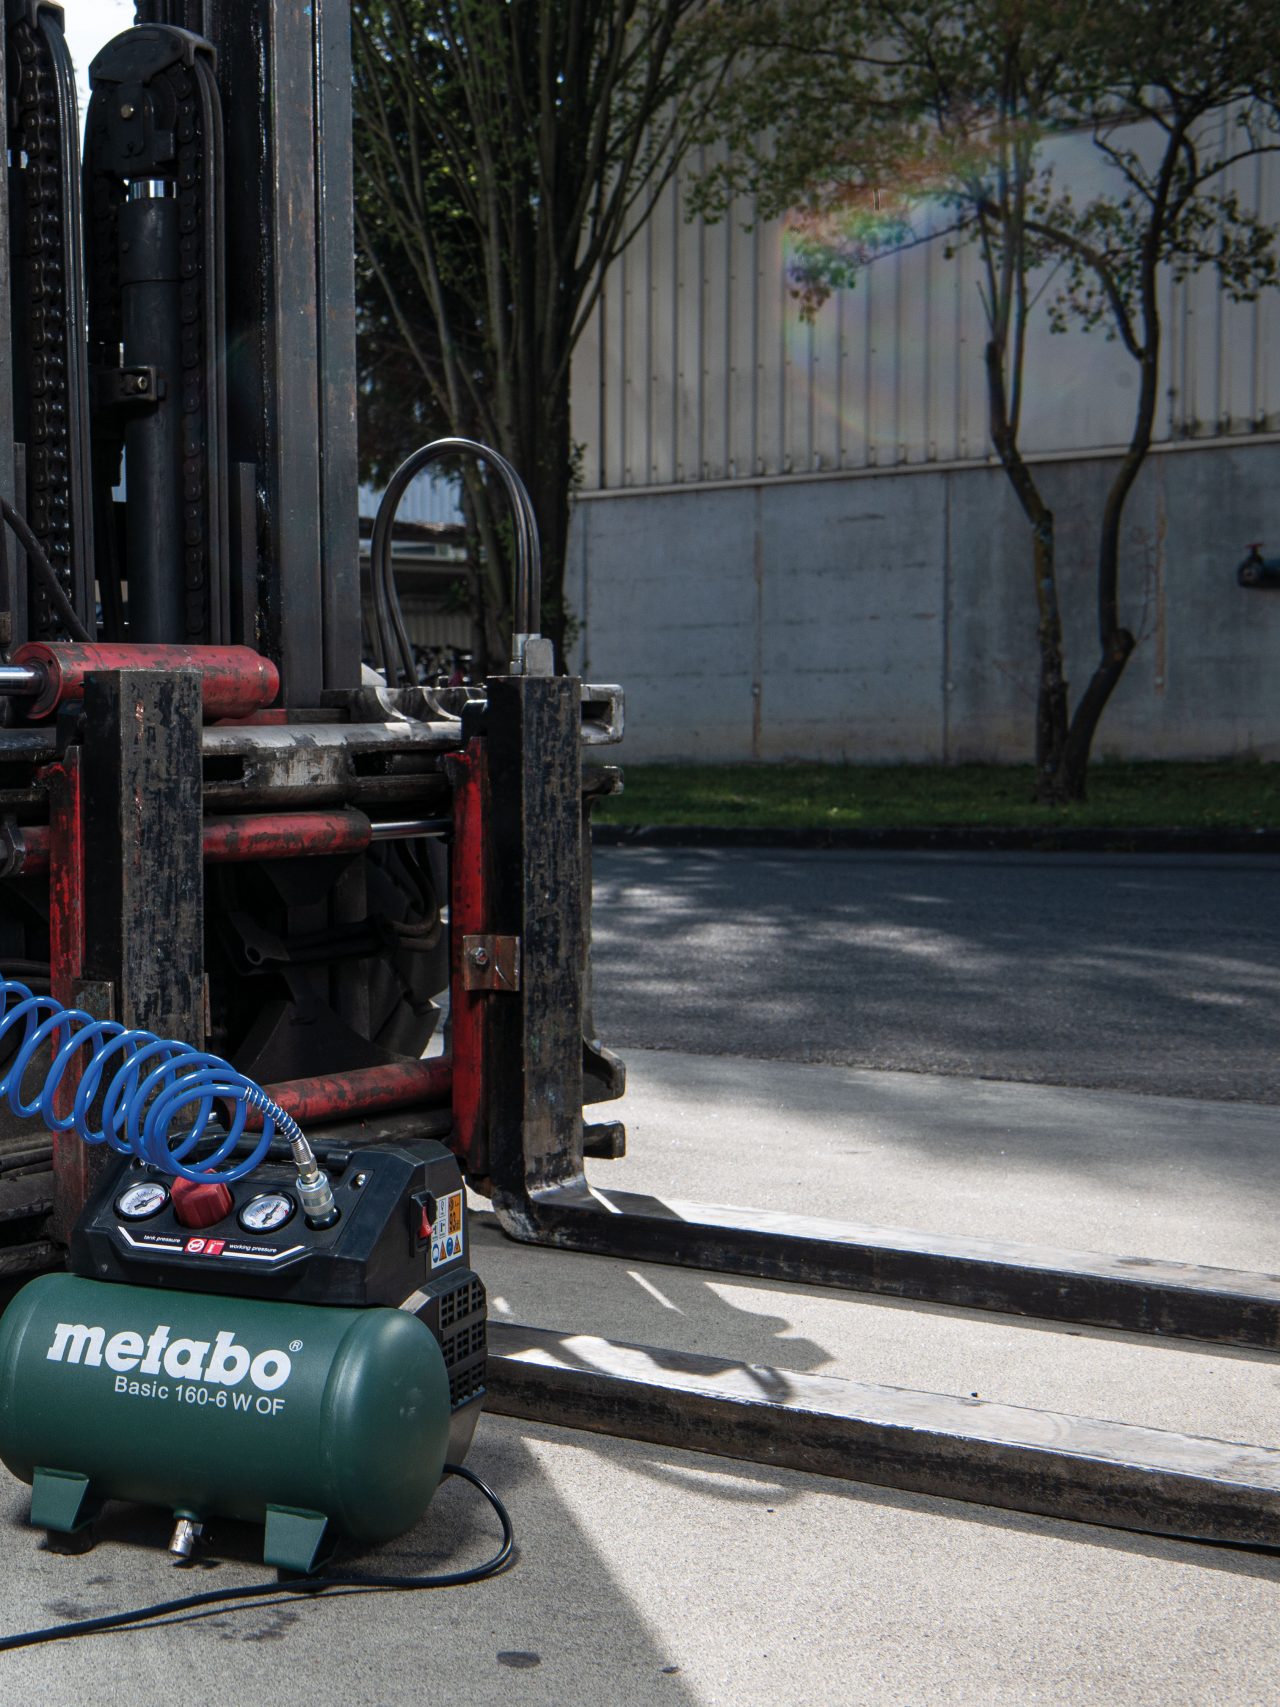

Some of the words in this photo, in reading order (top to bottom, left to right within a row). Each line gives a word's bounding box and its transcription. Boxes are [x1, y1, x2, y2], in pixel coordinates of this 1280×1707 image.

[143, 1234, 156, 1242] tank
[155, 1236, 181, 1244] pressure
[229, 1243, 251, 1252] working
[251, 1246, 277, 1254] pressure
[46, 1323, 292, 1391] metabo
[114, 1376, 169, 1400] Basic
[174, 1384, 228, 1409] 160-6
[231, 1391, 253, 1412] W
[255, 1395, 286, 1416] OF
